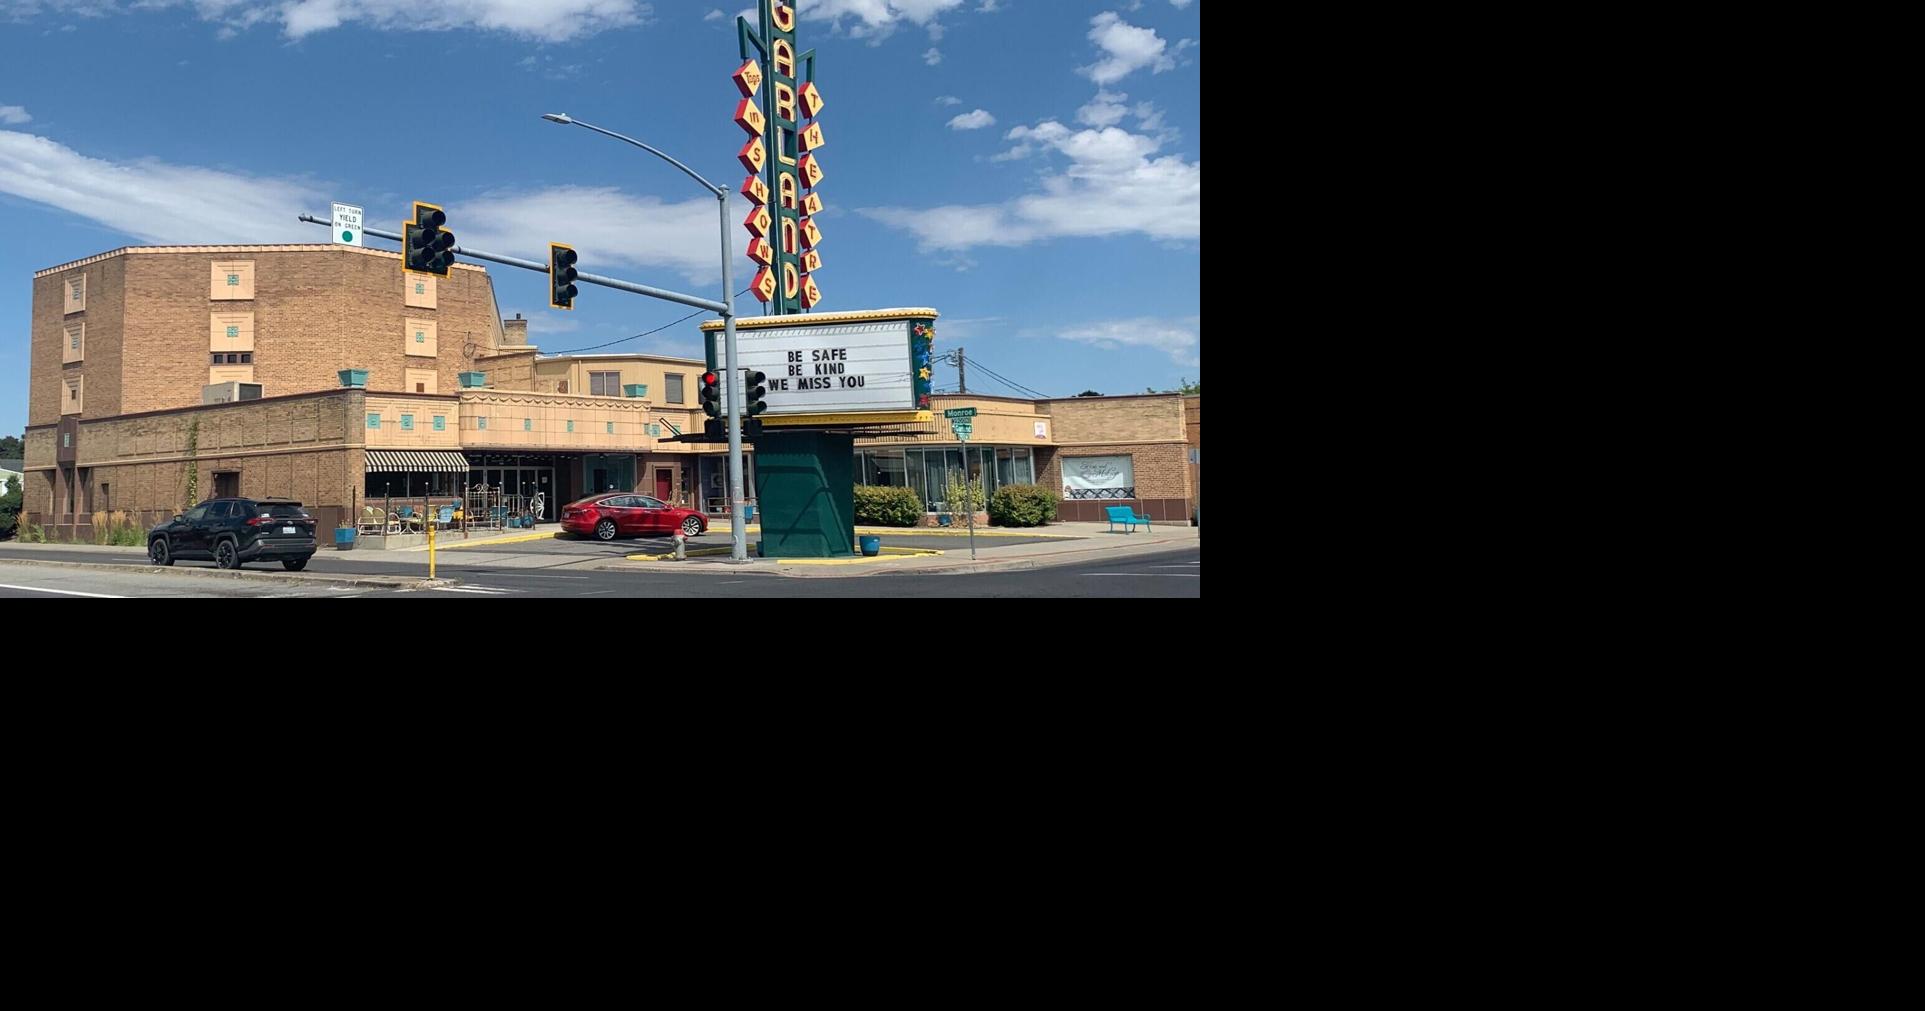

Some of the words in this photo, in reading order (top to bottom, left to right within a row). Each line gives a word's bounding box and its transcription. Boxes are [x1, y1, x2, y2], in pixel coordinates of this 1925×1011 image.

[769, 0, 799, 299] GARLAND
[339, 214, 357, 223] YIELD
[753, 147, 772, 295] SHOWS
[788, 351, 803, 362] BE
[812, 348, 847, 361] SAFE
[788, 365, 803, 376] BE
[815, 363, 845, 375] KIND
[768, 379, 789, 391] WE
[798, 377, 831, 390] MISS
[839, 375, 865, 388] YOU
